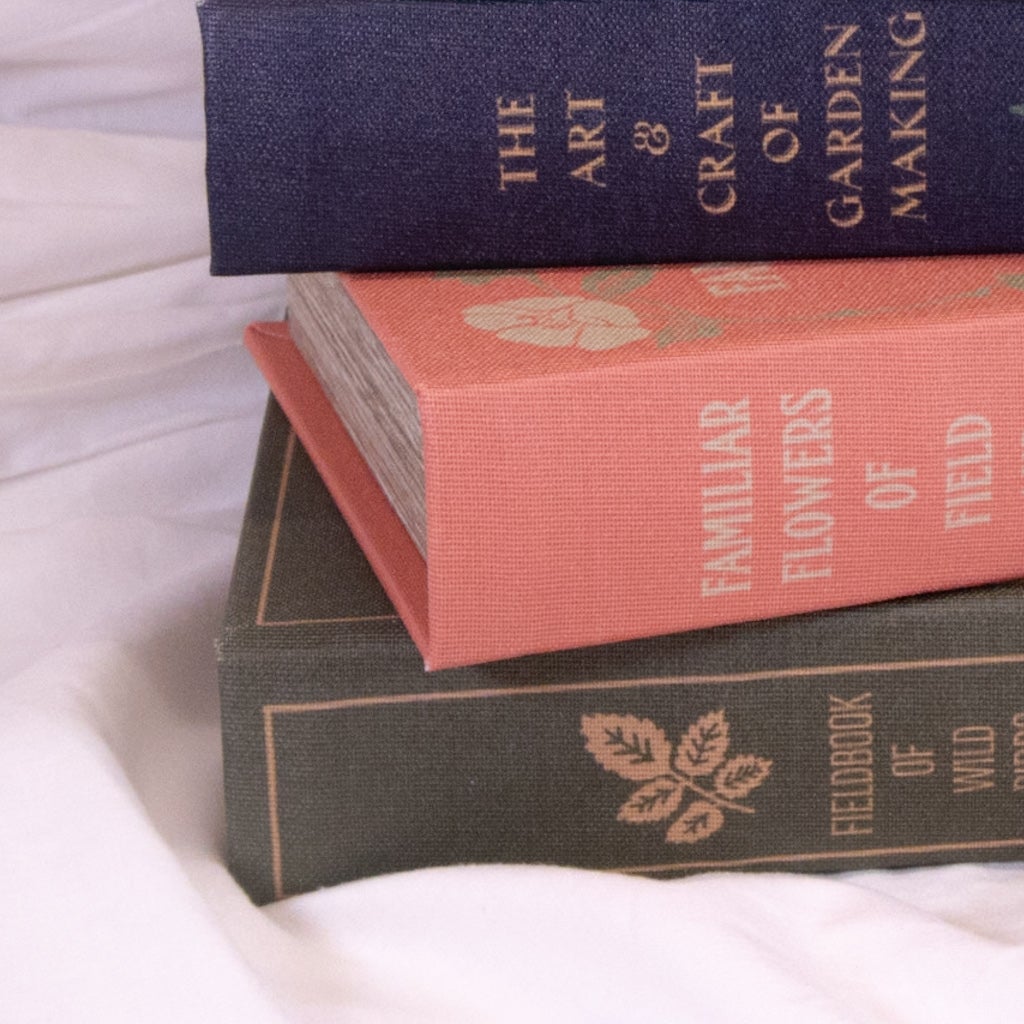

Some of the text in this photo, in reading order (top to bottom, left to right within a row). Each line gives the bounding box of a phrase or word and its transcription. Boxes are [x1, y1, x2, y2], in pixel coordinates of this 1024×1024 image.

[497, 92, 539, 192] THE
[565, 89, 607, 189] ART
[633, 119, 671, 157] &
[694, 56, 737, 216] CRAFT
[761, 100, 800, 164] OF
[824, 23, 865, 229] GARDEN
[888, 10, 928, 221] MAKING
[700, 396, 754, 598] FAMILIAR
[780, 388, 834, 584] FLOWERS
[865, 462, 917, 511] OF
[944, 413, 994, 531] FIELD
[828, 691, 874, 837] FIELDBOOK
[891, 743, 936, 777] OF
[952, 724, 996, 794] WILD
